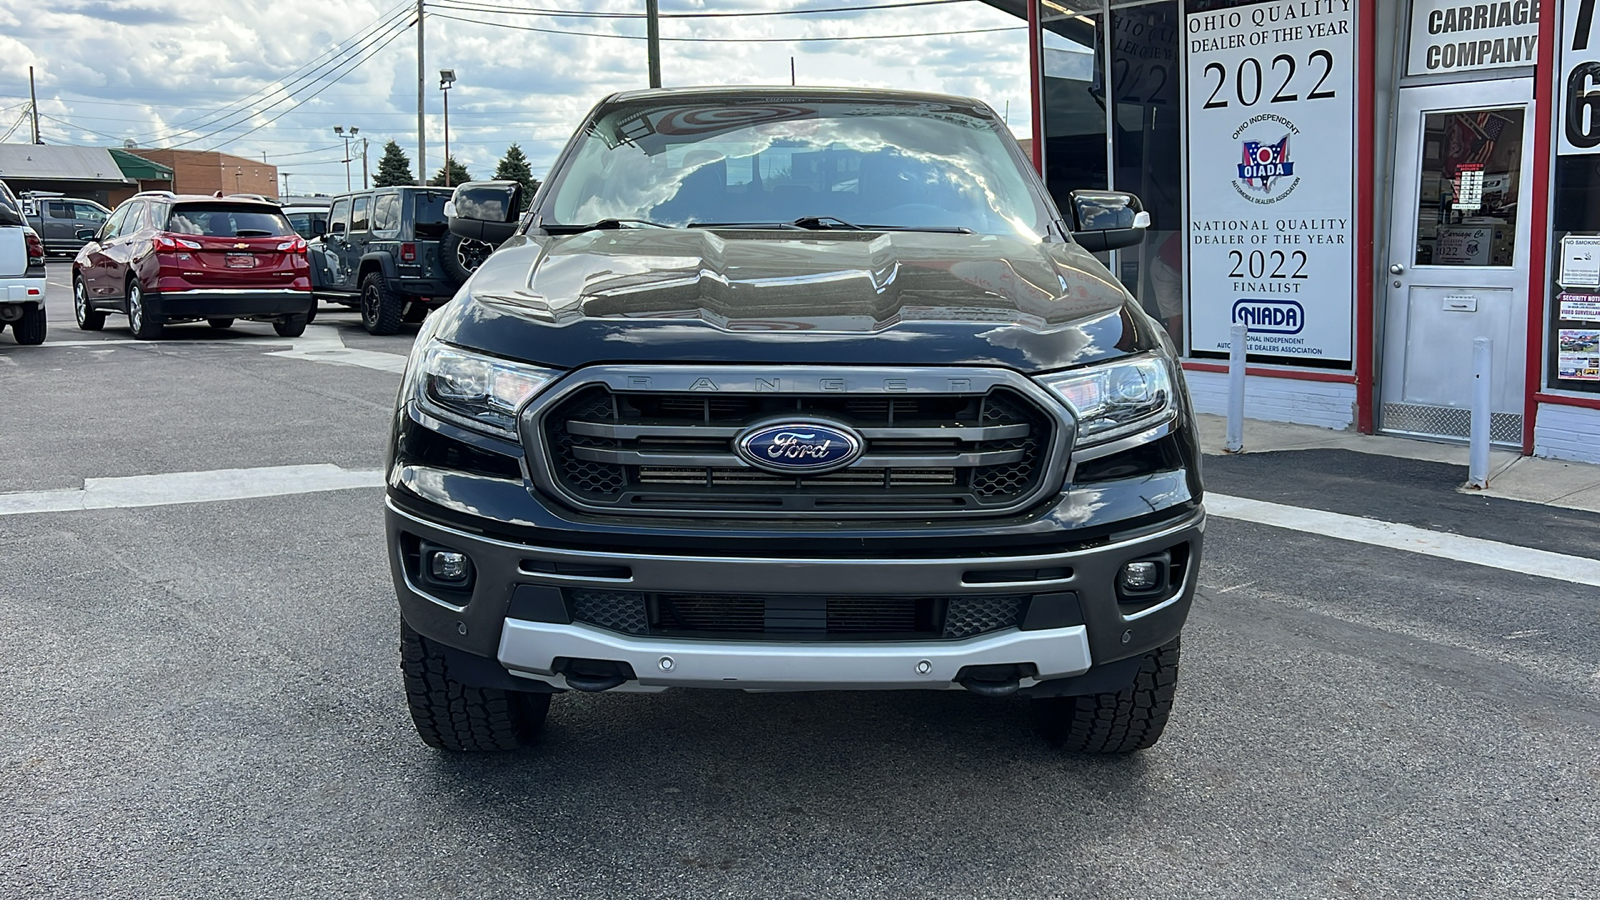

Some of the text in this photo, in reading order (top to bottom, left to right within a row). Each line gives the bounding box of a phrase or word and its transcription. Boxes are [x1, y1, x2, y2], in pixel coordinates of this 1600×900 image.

[1189, 0, 1350, 33] OHIO QUALITY
[1428, 0, 1540, 35] CARRIAGE
[1191, 34, 1246, 53] DEALER
[1249, 31, 1269, 46] OF
[1272, 26, 1303, 43] THE
[1307, 20, 1349, 38] YEAR
[1426, 35, 1538, 70] COMPANY
[1202, 49, 1335, 109] 2022
[1232, 113, 1300, 140] OHIO INDEPENDENT
[1244, 163, 1284, 177] OIADA
[1231, 176, 1301, 205] AUTOMOBILE DEALERS ASSOCIATION
[1193, 219, 1347, 231] NATIONAL QUALITY
[1194, 234, 1345, 245] DEALER OF THE YEAR
[1228, 250, 1309, 279] 2022
[1233, 282, 1301, 293] FINALIST
[1238, 306, 1297, 326] NIADA
[1217, 342, 1322, 354] AUTOLE DEALERS ASSOCIATION
[1263, 336, 1304, 344] INDEPENDENT
[627, 375, 972, 391] RANGER
[767, 431, 830, 458] Ford
